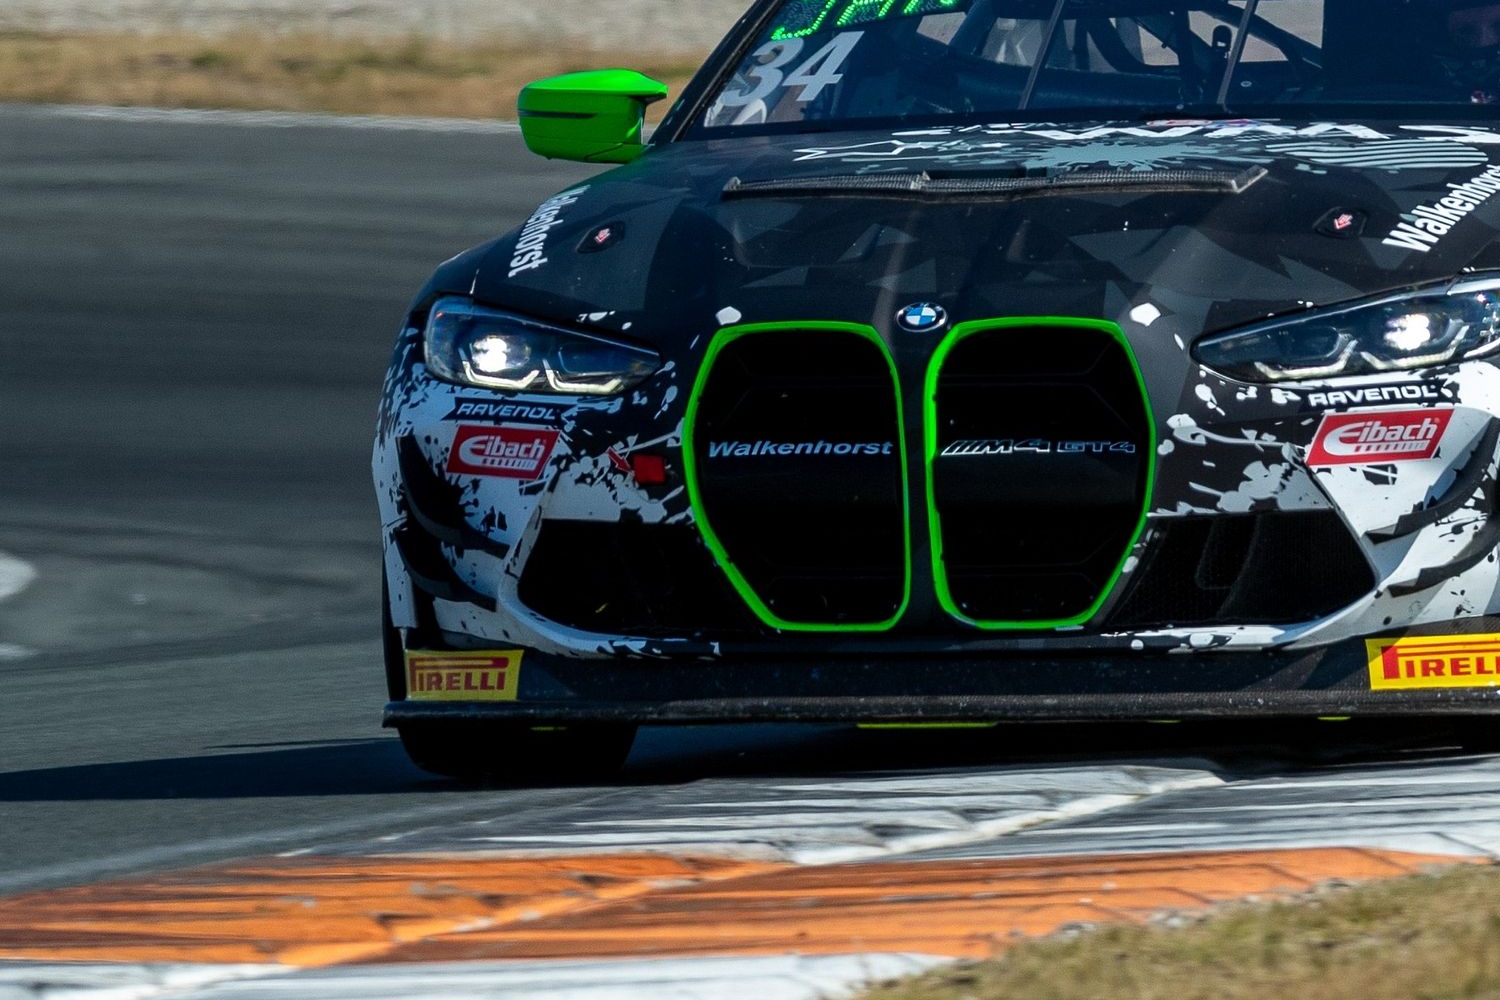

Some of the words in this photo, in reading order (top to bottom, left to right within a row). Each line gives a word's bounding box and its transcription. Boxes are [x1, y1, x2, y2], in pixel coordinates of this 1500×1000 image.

[720, 31, 865, 105] 34
[1308, 384, 1438, 407] RAVENOL
[457, 403, 555, 419] RAVENOL
[708, 440, 893, 457] Walkenhorst
[1057, 441, 1136, 454] GT4
[1323, 418, 1438, 456] Eibach
[459, 435, 545, 467] Eibach
[409, 656, 509, 692] PIRELLI
